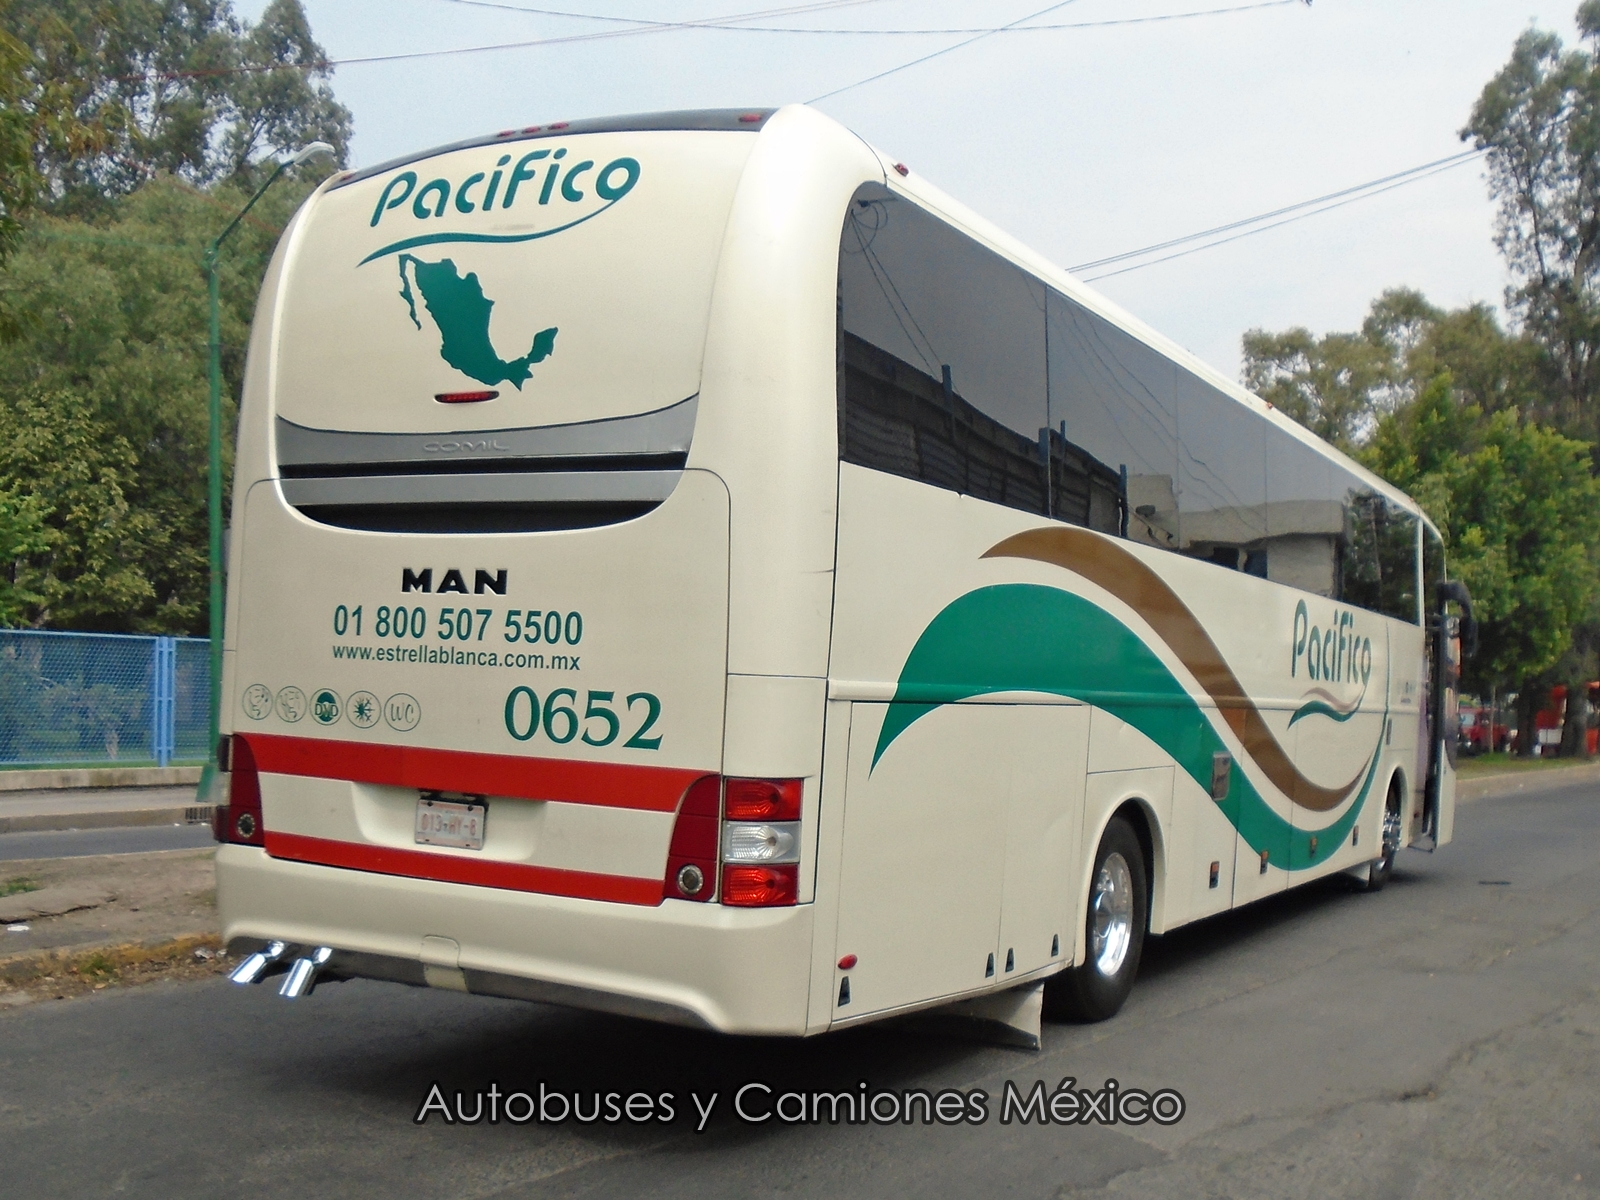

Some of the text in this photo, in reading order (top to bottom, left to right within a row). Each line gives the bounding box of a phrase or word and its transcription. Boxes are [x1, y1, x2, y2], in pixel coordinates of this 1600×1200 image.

[424, 439, 510, 453] COMIL
[401, 568, 508, 595] MAN
[334, 604, 584, 646] 01 800 507 5500
[332, 644, 581, 671] www.estrellablanca.com.mx
[505, 685, 664, 751] 0652
